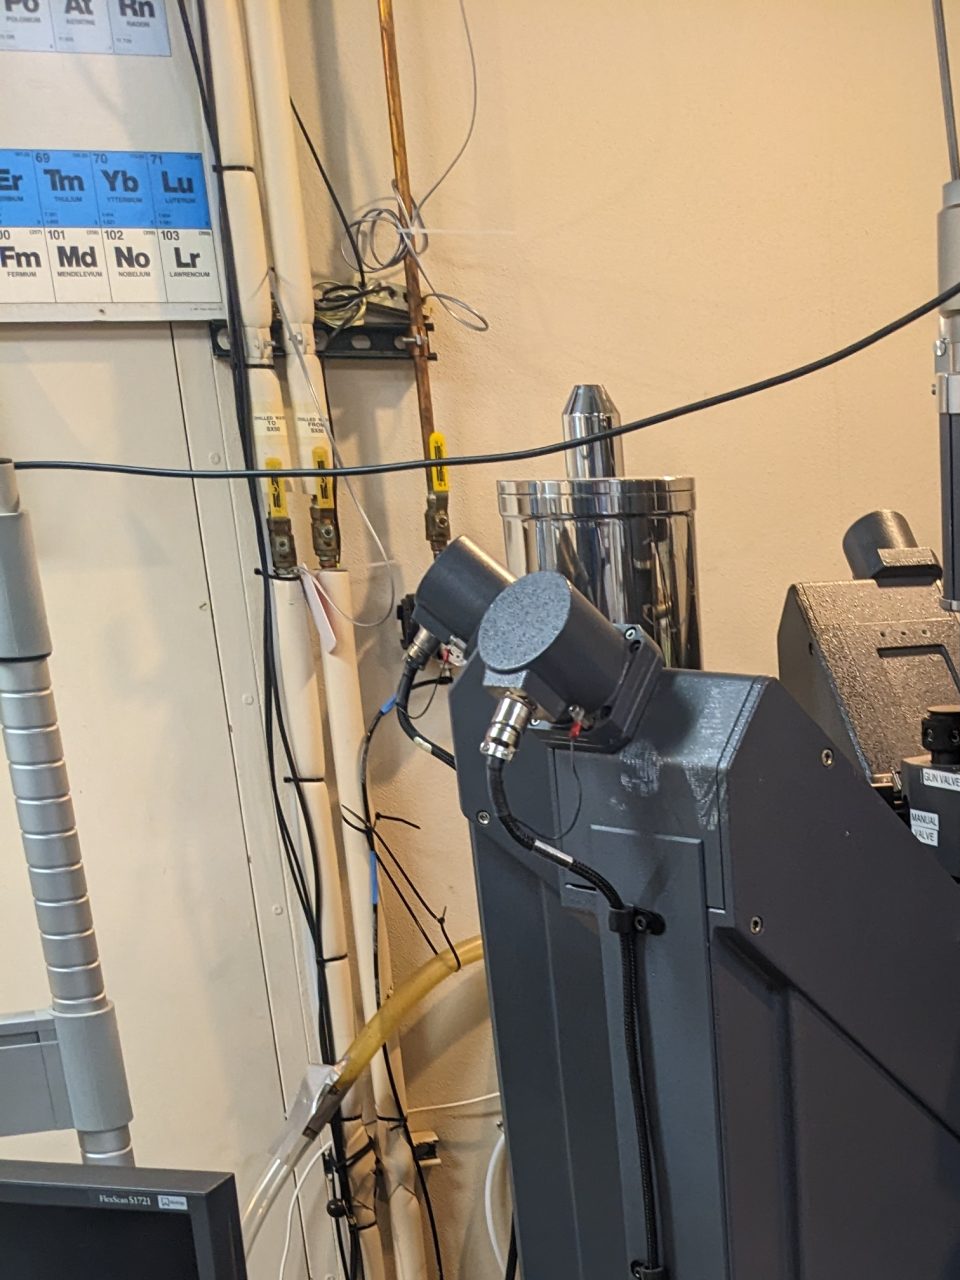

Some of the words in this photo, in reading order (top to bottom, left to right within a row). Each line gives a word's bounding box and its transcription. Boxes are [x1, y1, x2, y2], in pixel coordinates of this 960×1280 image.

[35, 152, 50, 163] 69
[93, 153, 108, 164] 70
[150, 154, 163, 165] 71
[43, 168, 85, 192] Tm
[100, 169, 139, 193] Yb
[161, 170, 194, 194] Lu
[48, 230, 65, 240] 101
[105, 230, 124, 241] 102
[161, 230, 180, 241] 103
[0, 246, 42, 268] Fm
[57, 246, 98, 268] Md
[114, 246, 151, 268] No
[173, 247, 201, 268] Lr
[940, 775, 960, 788] VALVE
[911, 812, 938, 827] MANUAL
[913, 829, 936, 842] VALVE
